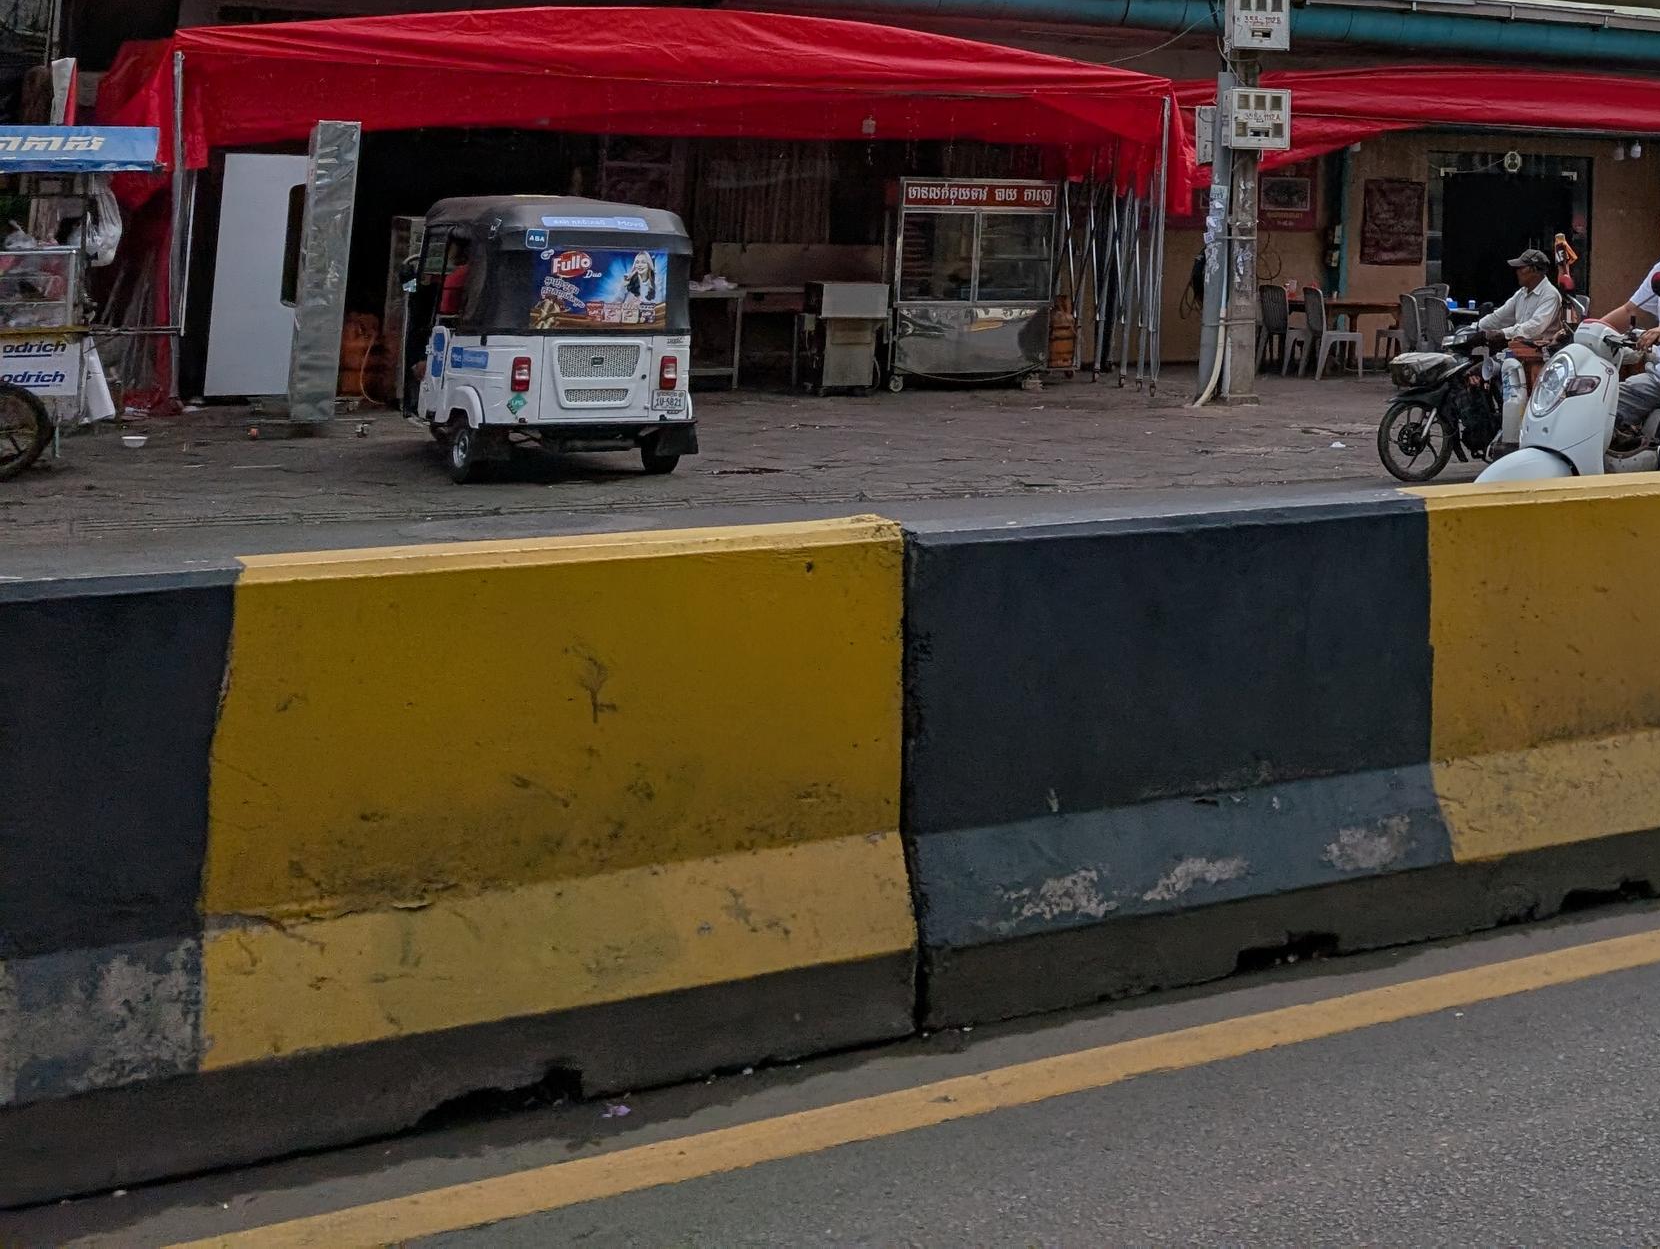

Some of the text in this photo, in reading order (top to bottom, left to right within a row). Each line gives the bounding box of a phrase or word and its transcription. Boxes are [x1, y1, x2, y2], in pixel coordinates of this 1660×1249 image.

[551, 253, 592, 273] Fullo
[583, 270, 602, 279] Duo
[2, 340, 67, 355] odrich
